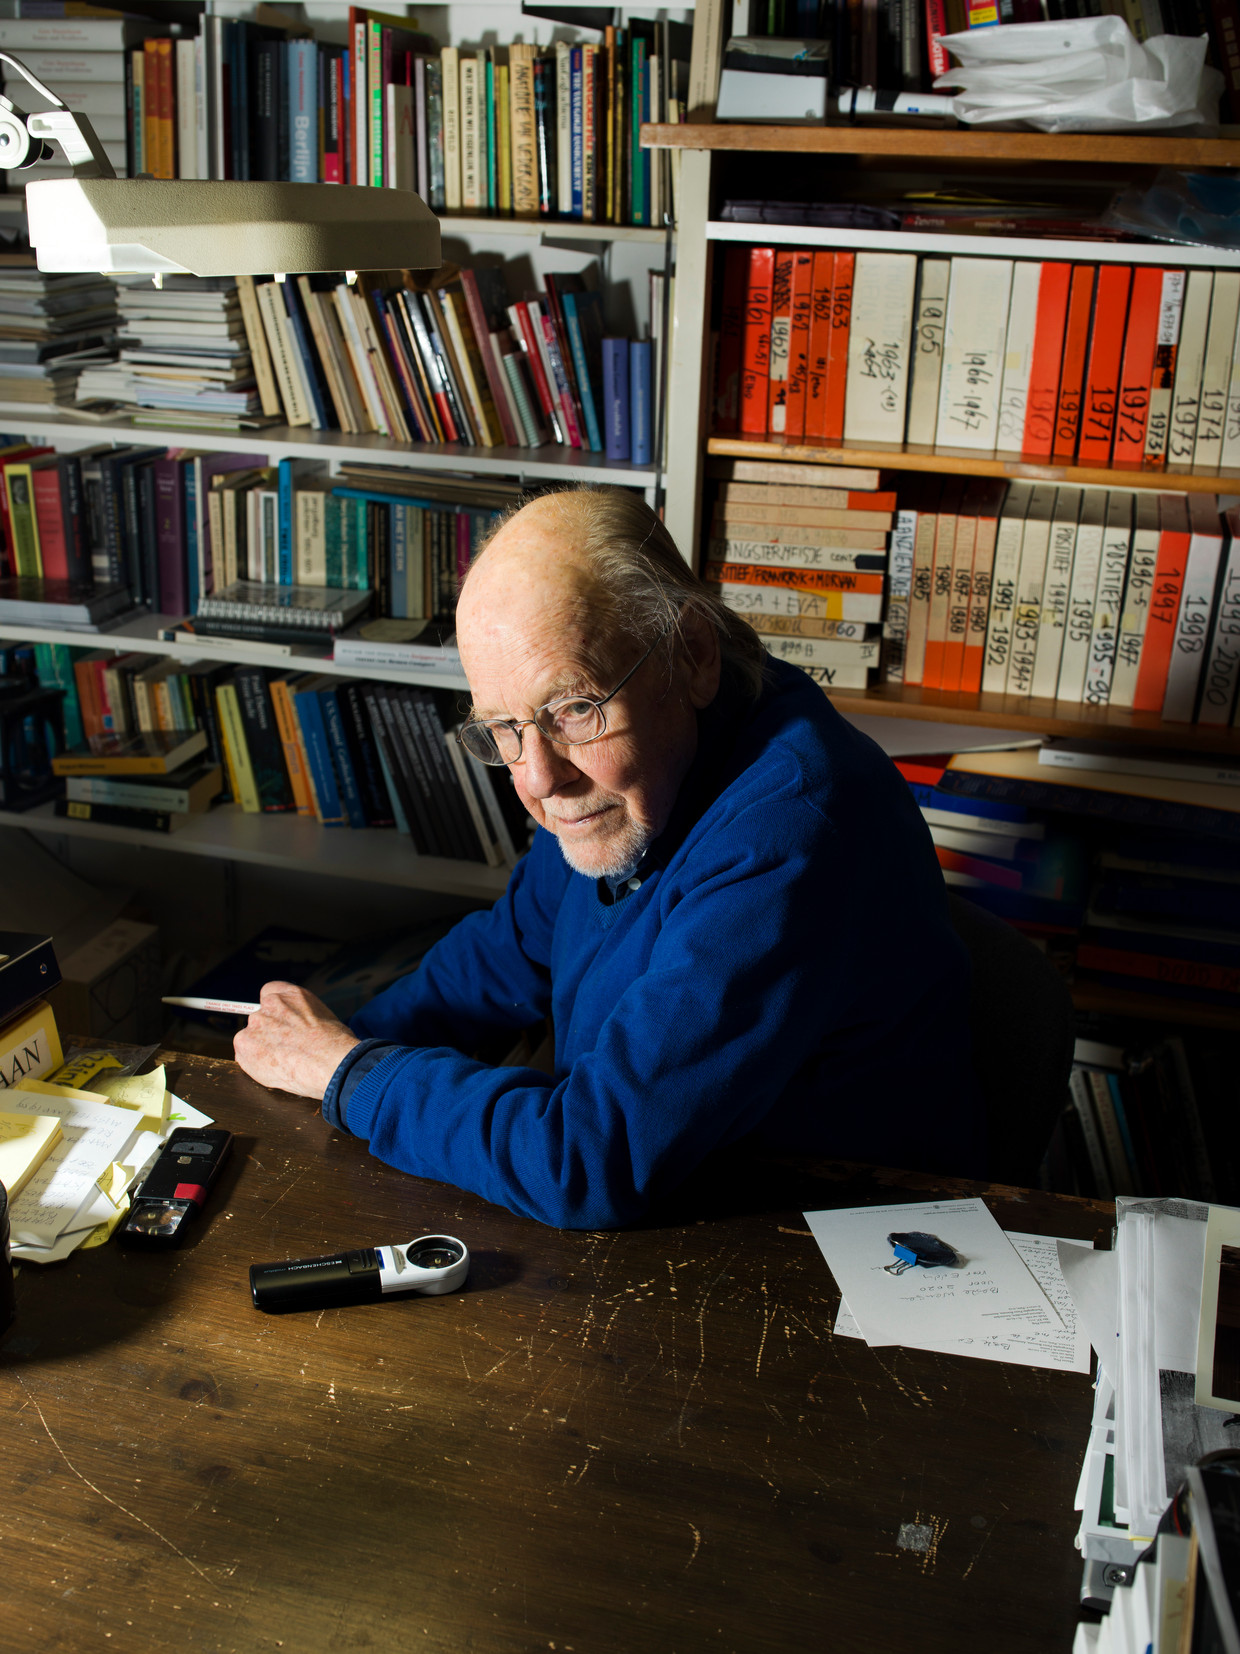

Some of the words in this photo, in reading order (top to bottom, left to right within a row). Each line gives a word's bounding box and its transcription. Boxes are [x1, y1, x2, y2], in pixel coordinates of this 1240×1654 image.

[294, 116, 309, 177] Berlijn
[744, 286, 769, 325] 1961
[792, 293, 810, 332] 1962
[814, 287, 830, 322] 1962
[832, 283, 849, 329] 1963
[773, 321, 788, 364] 1962
[877, 342, 900, 381] 1963
[1059, 389, 1079, 440] 1970
[1084, 385, 1114, 443] 1971
[1119, 385, 1148, 444] 1972
[1148, 412, 1166, 450] 1973
[1170, 395, 1196, 458] 1973
[1198, 389, 1224, 442] 1974
[396, 521, 404, 540] HET
[1053, 527, 1074, 576] POSITIEF
[396, 544, 404, 571] WERK
[1100, 541, 1126, 613] POSITIEF
[913, 567, 930, 602] 1985
[935, 564, 951, 596] 1986
[950, 569, 970, 634] 1987-1988
[971, 571, 990, 633] 1989-1990
[1152, 568, 1180, 625] 1997
[787, 596, 827, 615] EVA
[1070, 597, 1092, 642] 1995
[1178, 595, 1208, 654] 1998
[821, 621, 856, 637] 1960
[1119, 632, 1144, 667] 1997
[288, 1261, 335, 1270] ESCHENBACH
